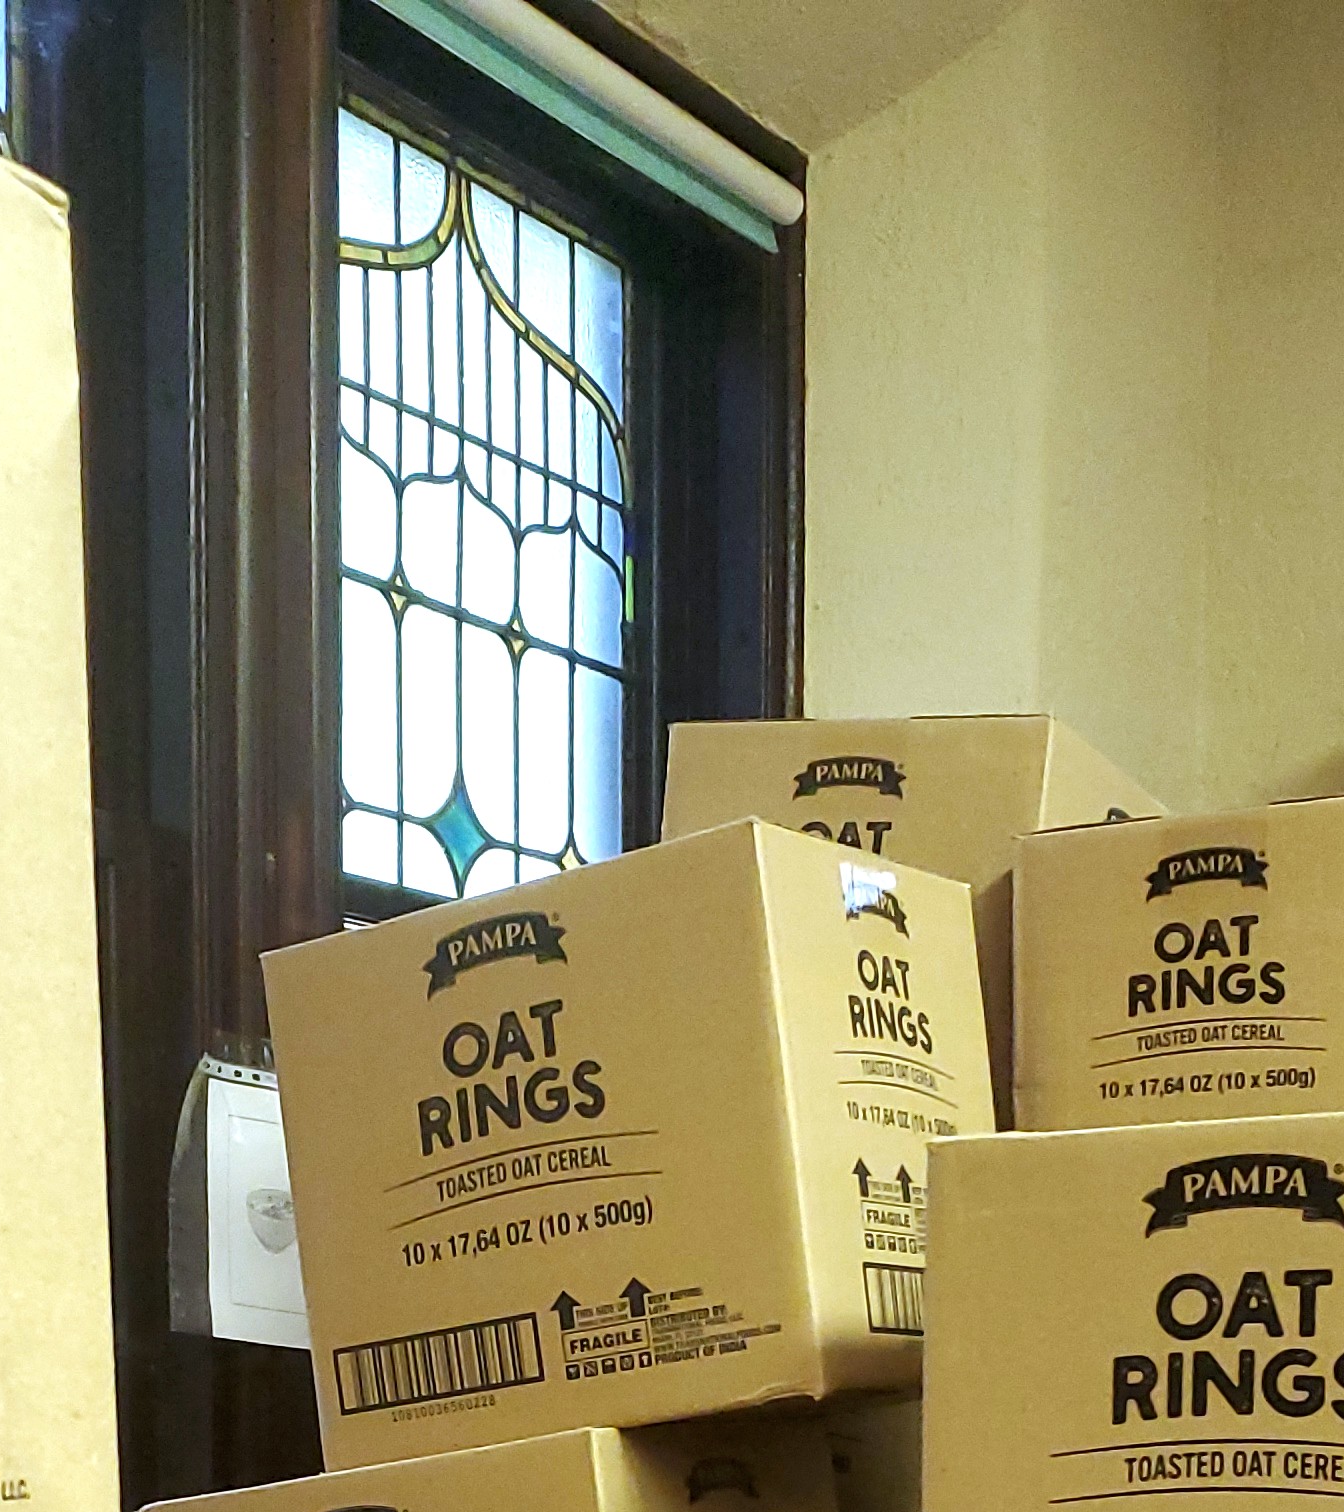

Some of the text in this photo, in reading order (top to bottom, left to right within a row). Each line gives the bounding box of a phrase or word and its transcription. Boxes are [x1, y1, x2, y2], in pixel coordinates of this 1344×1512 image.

[816, 762, 884, 784] PAMPA
[1168, 852, 1246, 880] PAMPA
[447, 922, 537, 966] PAMPA
[1154, 915, 1259, 963] OAT
[857, 949, 909, 1001] OAT
[1128, 960, 1286, 1018] RINGS
[443, 999, 564, 1078] OAT
[848, 994, 933, 1054] RINGS
[1136, 1023, 1285, 1053] TOASTED OAT CEREAL
[417, 1060, 606, 1156] RINGS
[435, 1145, 612, 1203] TOASTED OAT CEREAL
[1182, 1164, 1308, 1203] PAMPA
[402, 1196, 654, 1269] 10 x 17,64 OZ (10 x 500g)
[1156, 1268, 1333, 1341] OAT
[569, 1328, 643, 1355] FRAGILE
[1125, 1453, 1225, 1486] TOASTED
[1231, 1453, 1277, 1482] OAT
